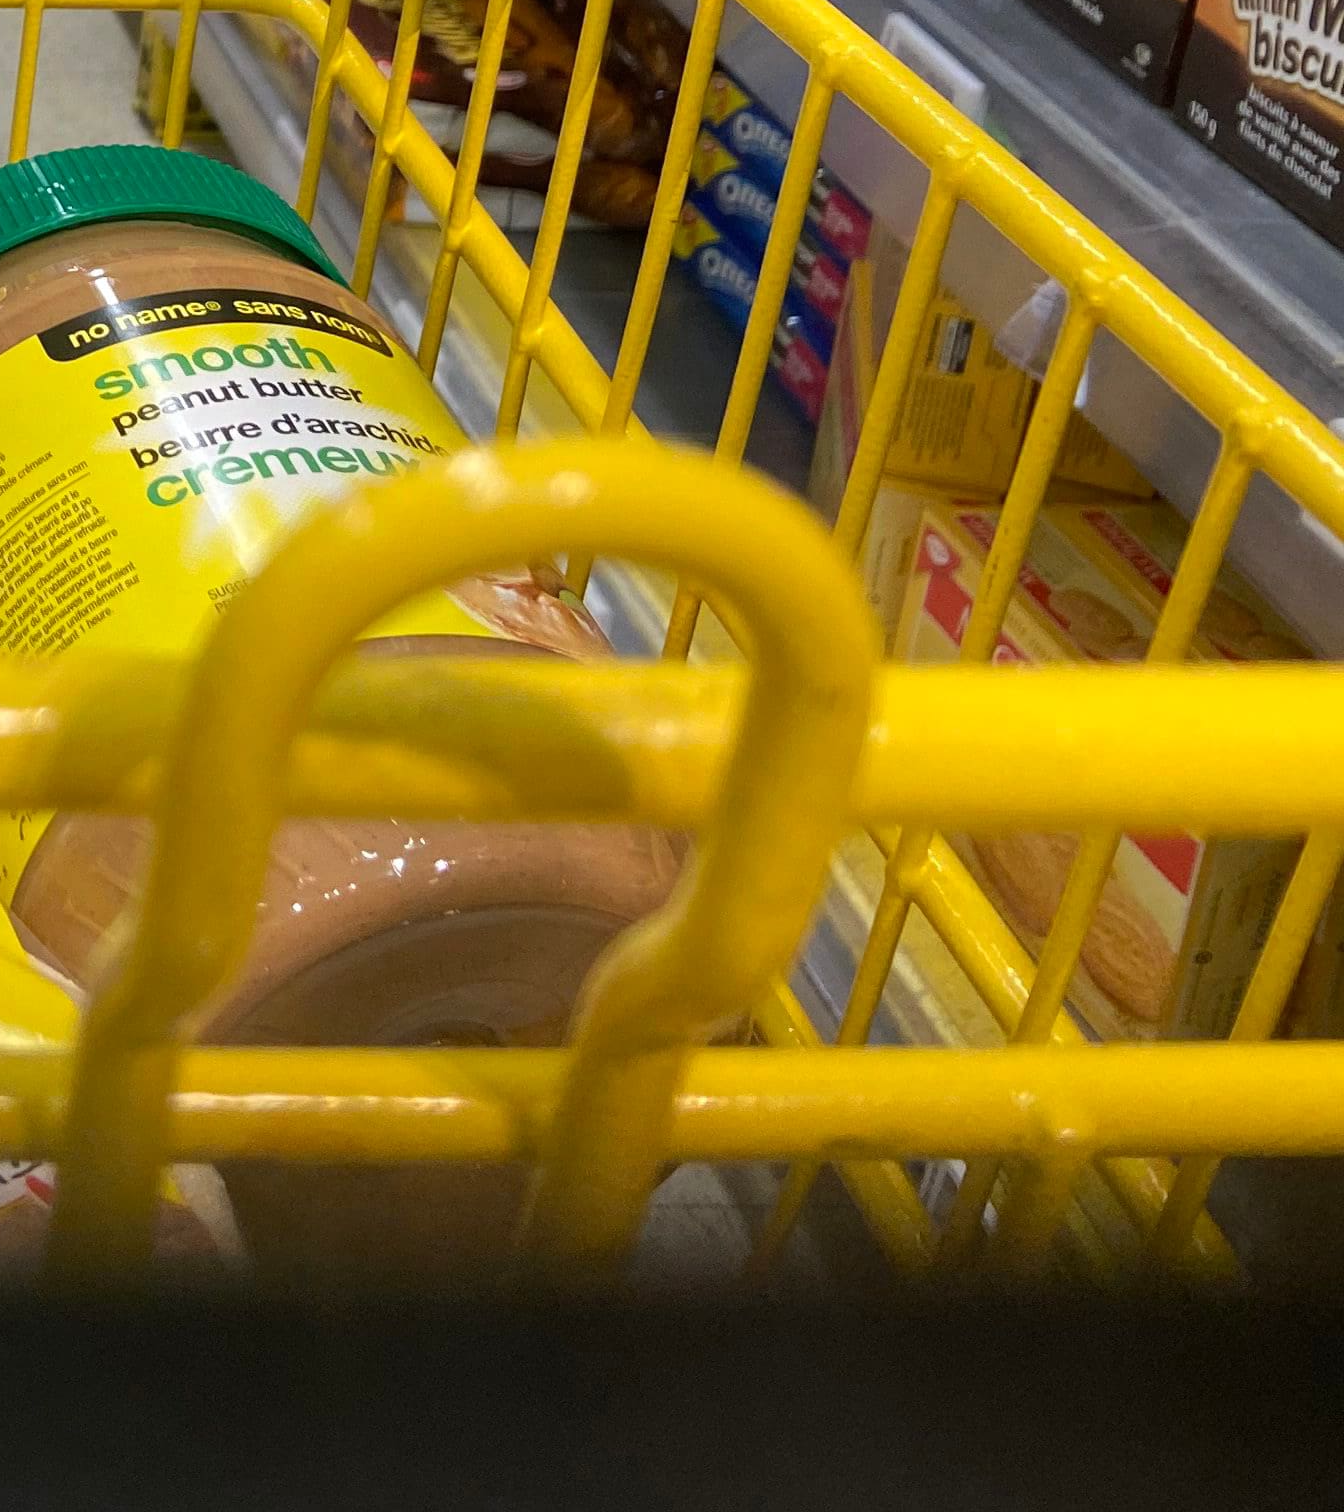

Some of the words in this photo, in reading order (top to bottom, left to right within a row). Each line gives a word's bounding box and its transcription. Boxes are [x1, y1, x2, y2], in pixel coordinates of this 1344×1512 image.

[1248, 82, 1289, 125] biscuits
[1256, 112, 1291, 145] vanille
[1292, 139, 1318, 167] avec
[1320, 156, 1341, 185] des
[1284, 155, 1334, 200] chocolat
[68, 317, 110, 348] no
[232, 299, 306, 321] sans
[94, 337, 337, 401] smooth
[112, 380, 250, 437] peanut
[254, 377, 362, 405] butter
[67, 459, 89, 478] nom
[130, 420, 262, 469] beurre
